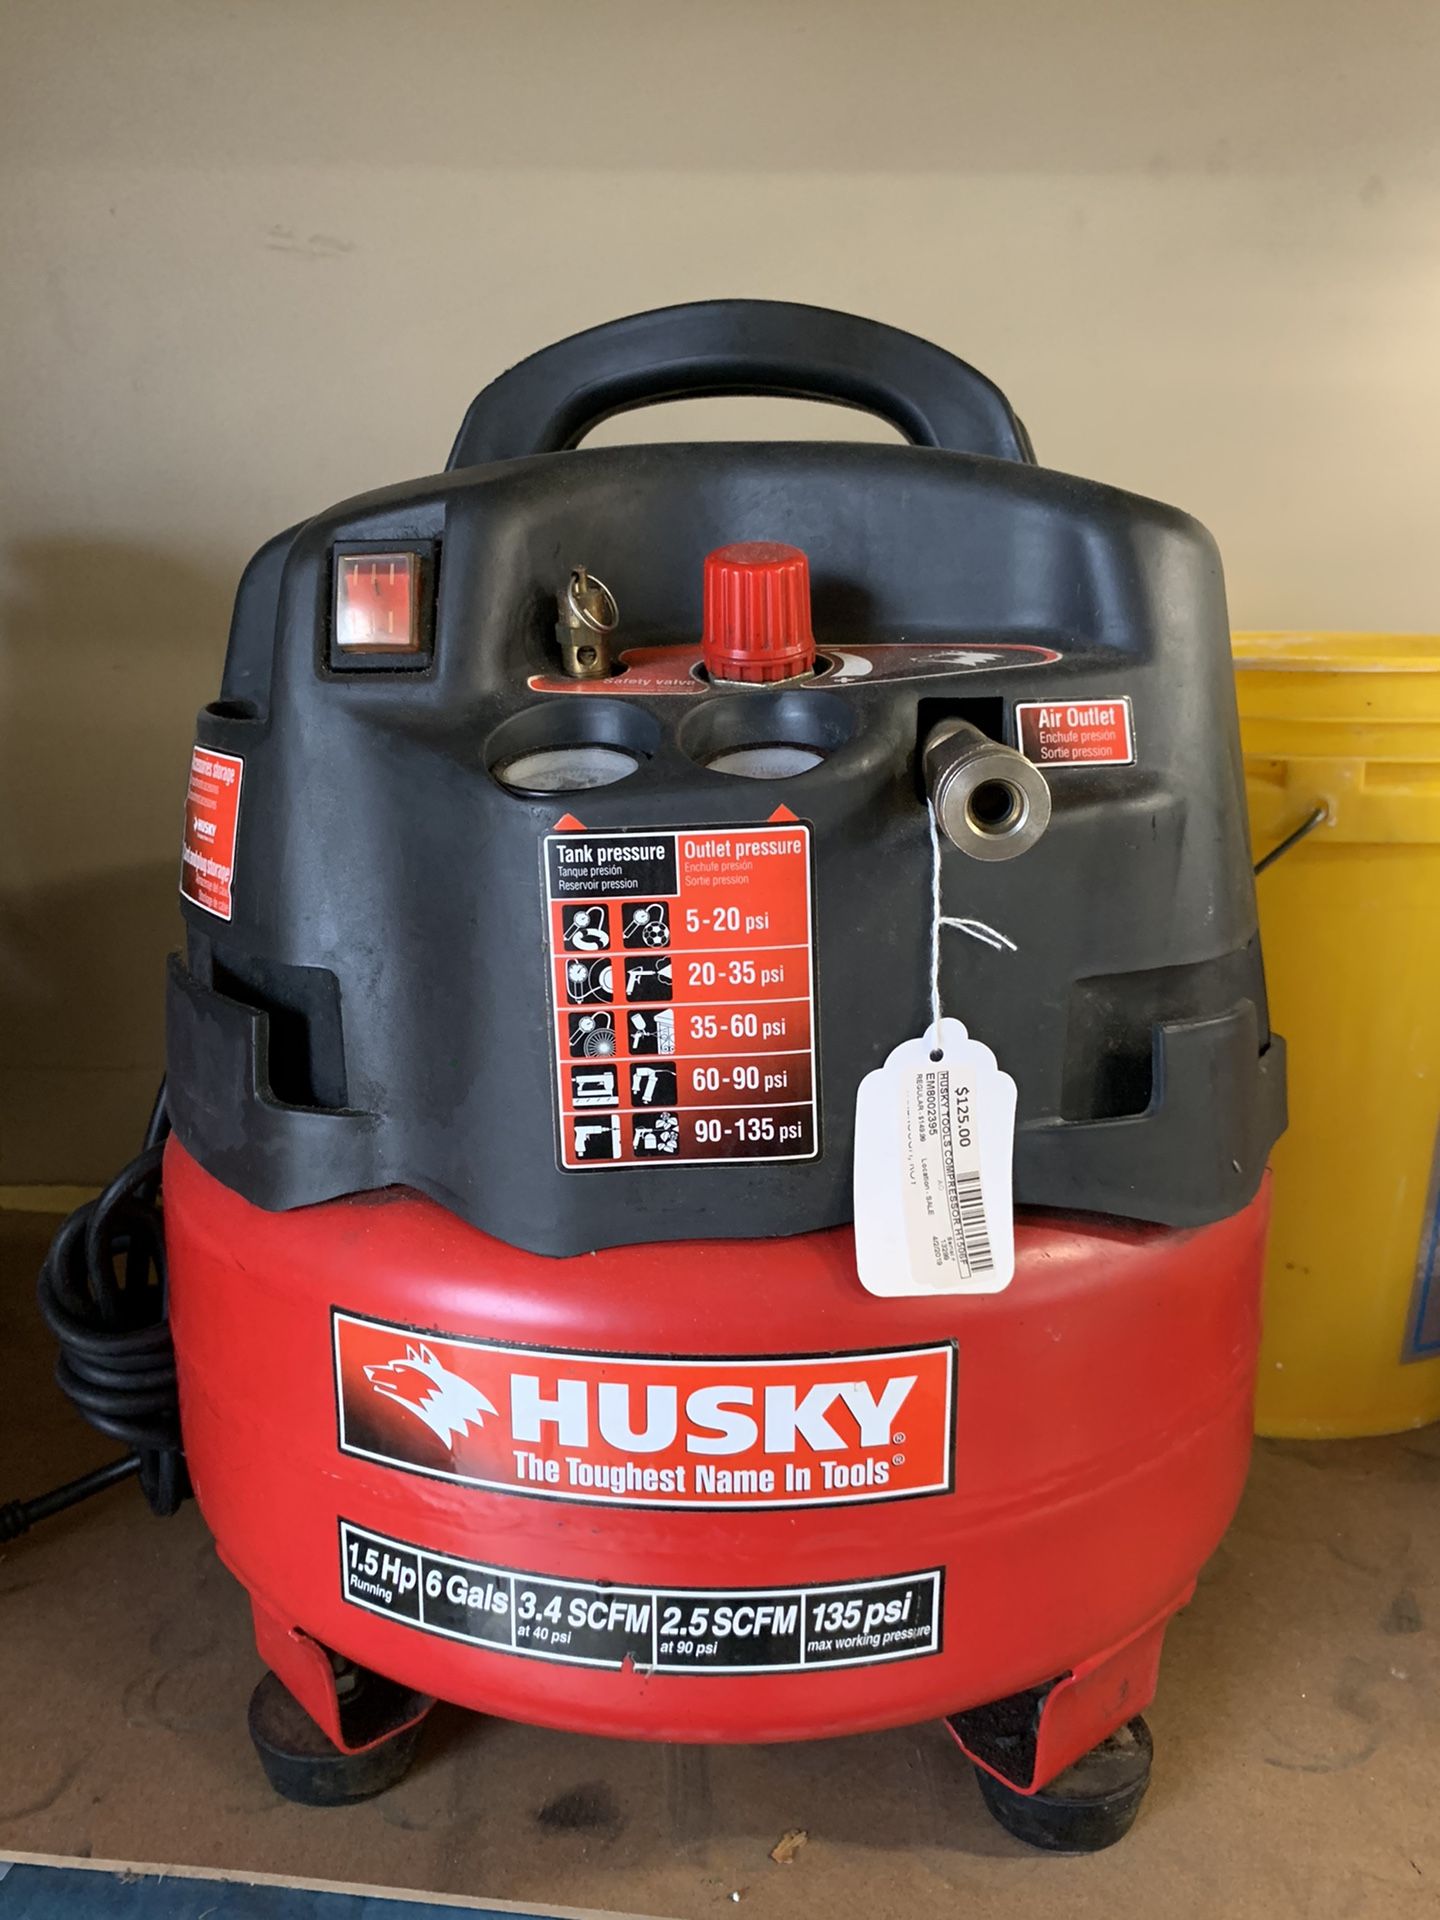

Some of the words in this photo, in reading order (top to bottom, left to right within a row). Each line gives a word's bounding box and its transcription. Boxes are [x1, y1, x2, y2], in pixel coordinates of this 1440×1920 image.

[1038, 709, 1062, 728] Air
[1066, 707, 1115, 727] Outlet
[1040, 732, 1078, 744] Enchufe
[1080, 730, 1116, 743] presión
[1040, 747, 1069, 760] Sortie
[1072, 745, 1112, 759] pression
[557, 844, 594, 863] Tank
[597, 845, 665, 865] pressure
[684, 840, 731, 860] Outlet
[735, 839, 802, 861] pressure
[558, 866, 588, 878] Tanque
[590, 865, 622, 878] presión
[684, 861, 719, 873] Enchufe
[721, 861, 753, 873] presión
[559, 878, 599, 891] Reservoir
[601, 877, 638, 891] pression
[684, 875, 711, 887] Sortie
[712, 875, 749, 887] pression
[686, 907, 740, 933] 5-20
[745, 912, 769, 933] psi
[687, 960, 756, 987] 20-35
[760, 964, 785, 987] psi
[690, 1012, 758, 1040] 35-60
[762, 1017, 786, 1040] psi
[692, 1065, 760, 1092] 60-90
[764, 1069, 788, 1092] psi
[939, 1071, 949, 1109] HUSKY
[916, 1073, 924, 1112] REGULAR
[926, 1072, 938, 1135] EM8002395
[694, 1117, 775, 1144] 90-135
[779, 1120, 803, 1142] psi
[942, 1111, 952, 1148] TOOLS
[954, 1086, 971, 1148] $125.00
[921, 1158, 929, 1189] Location
[926, 1195, 934, 1215] SALE
[944, 1149, 960, 1225] COMPRESSOR
[510, 1373, 918, 1455] HUSKY
[513, 1450, 559, 1486] The
[565, 1455, 686, 1496] Toughest
[696, 1462, 774, 1494] Name
[785, 1461, 810, 1492] In
[820, 1457, 889, 1488] Tools
[349, 1542, 379, 1578] 1.5
[381, 1554, 416, 1594] Hp
[350, 1573, 393, 1603] Running
[425, 1569, 443, 1598] 6
[446, 1574, 509, 1614] Gals
[518, 1591, 562, 1624] 3.4
[567, 1598, 651, 1634] SCFM
[660, 1606, 709, 1636] 2.5
[712, 1604, 798, 1637] SCFM
[811, 1600, 863, 1632] 135
[863, 1591, 912, 1635] psi
[517, 1625, 530, 1638] at
[533, 1627, 548, 1641] 40
[551, 1631, 572, 1645] psi
[660, 1642, 674, 1654] at
[676, 1641, 693, 1654] 90
[695, 1640, 718, 1657] psi
[807, 1638, 832, 1652] max
[835, 1633, 880, 1650] working
[882, 1625, 931, 1645] pressure
